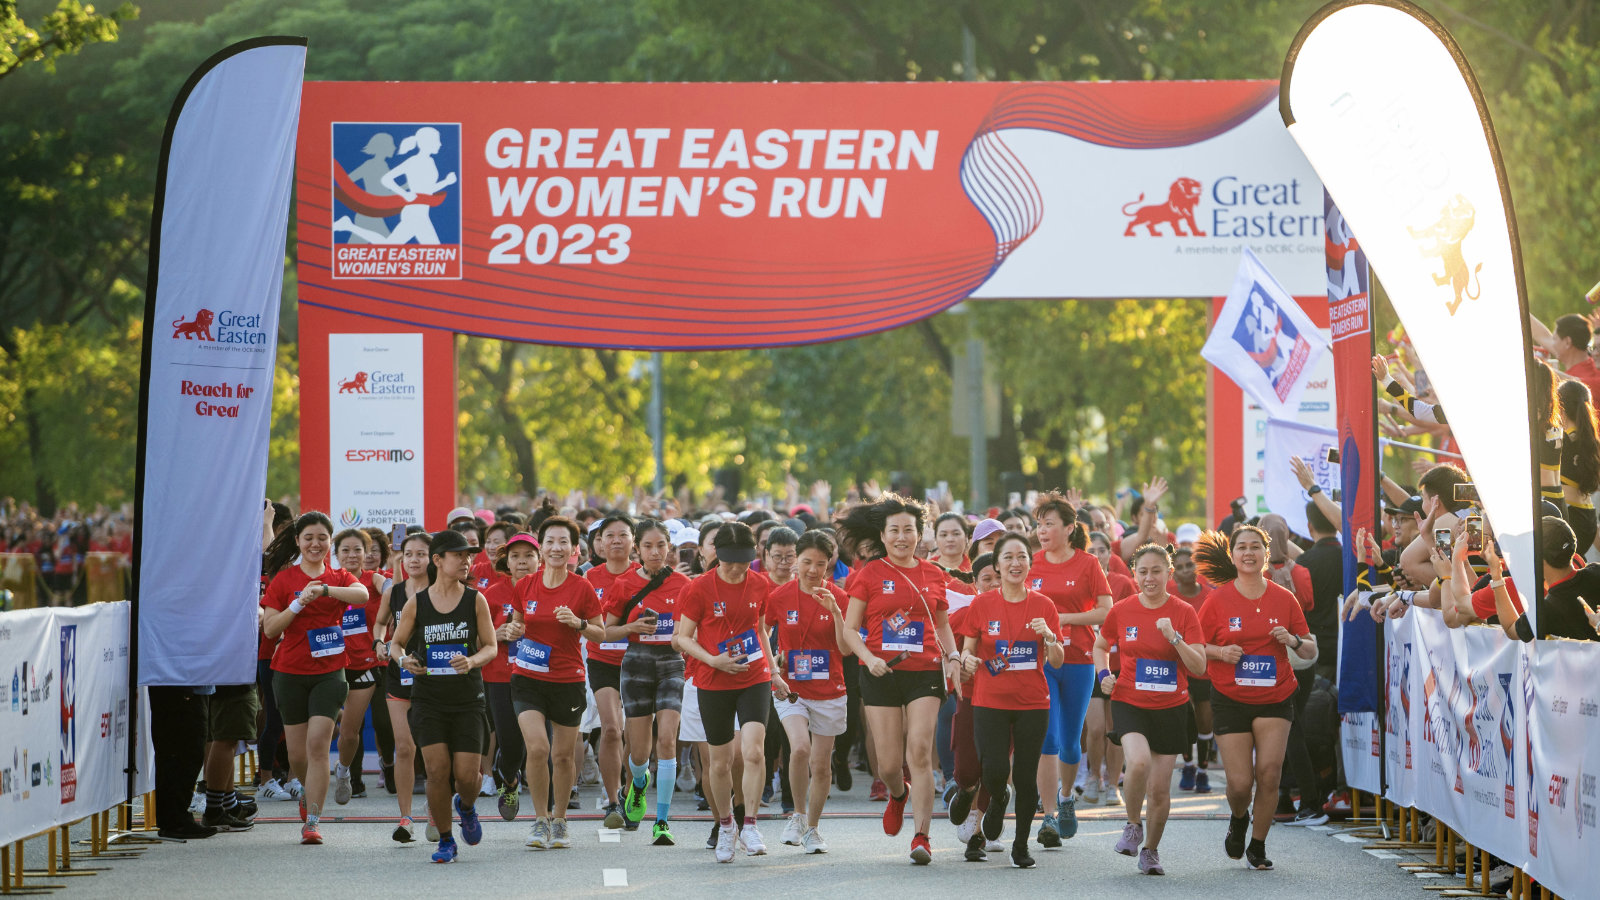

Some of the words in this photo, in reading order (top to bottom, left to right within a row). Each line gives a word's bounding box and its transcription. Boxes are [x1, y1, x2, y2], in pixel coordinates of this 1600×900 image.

[485, 128, 670, 169] GREAT
[679, 128, 939, 170] EASTERN
[487, 176, 758, 217] WOMEN'S
[768, 177, 887, 218] RUN
[1212, 176, 1301, 206] Great
[487, 223, 632, 264] 2023
[338, 248, 386, 261] GREAT
[388, 248, 457, 261] EASTERN
[339, 262, 411, 275] WOMEN'S
[414, 262, 446, 275] RUN
[218, 310, 261, 328] Great
[371, 371, 404, 383] Great
[181, 380, 233, 398] Reach
[371, 382, 415, 394] Eastern
[345, 449, 415, 463] ESPRIMO
[424, 622, 455, 635] RUNNING
[315, 632, 338, 643] 68118
[424, 629, 469, 643] DEPARTMENT
[742, 636, 753, 647] 77
[522, 645, 545, 659] 76688
[811, 656, 824, 664] 68
[1242, 661, 1271, 671] 99177
[1145, 666, 1169, 676] 9518
